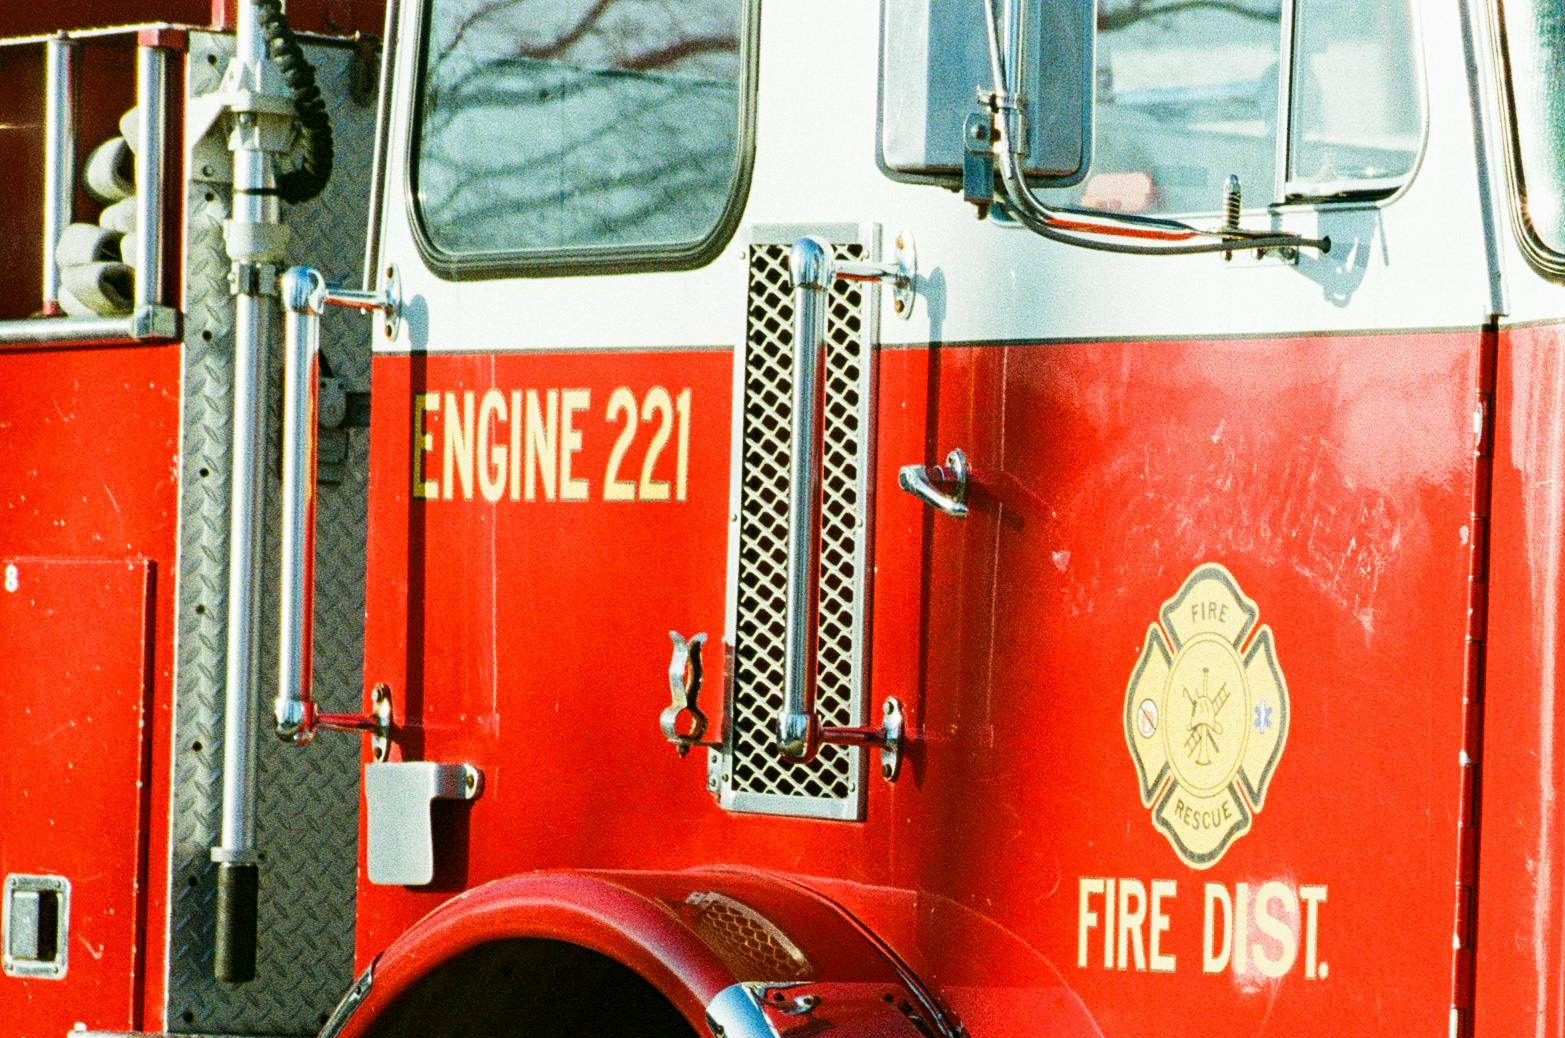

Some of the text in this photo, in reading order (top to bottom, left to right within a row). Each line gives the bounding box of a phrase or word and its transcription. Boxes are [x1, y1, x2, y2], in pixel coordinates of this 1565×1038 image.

[412, 386, 692, 502] ENGINE 221
[1191, 602, 1229, 623] FIRE
[1174, 798, 1233, 830] RESCUE
[1077, 876, 1330, 981] FIRE DIST.
